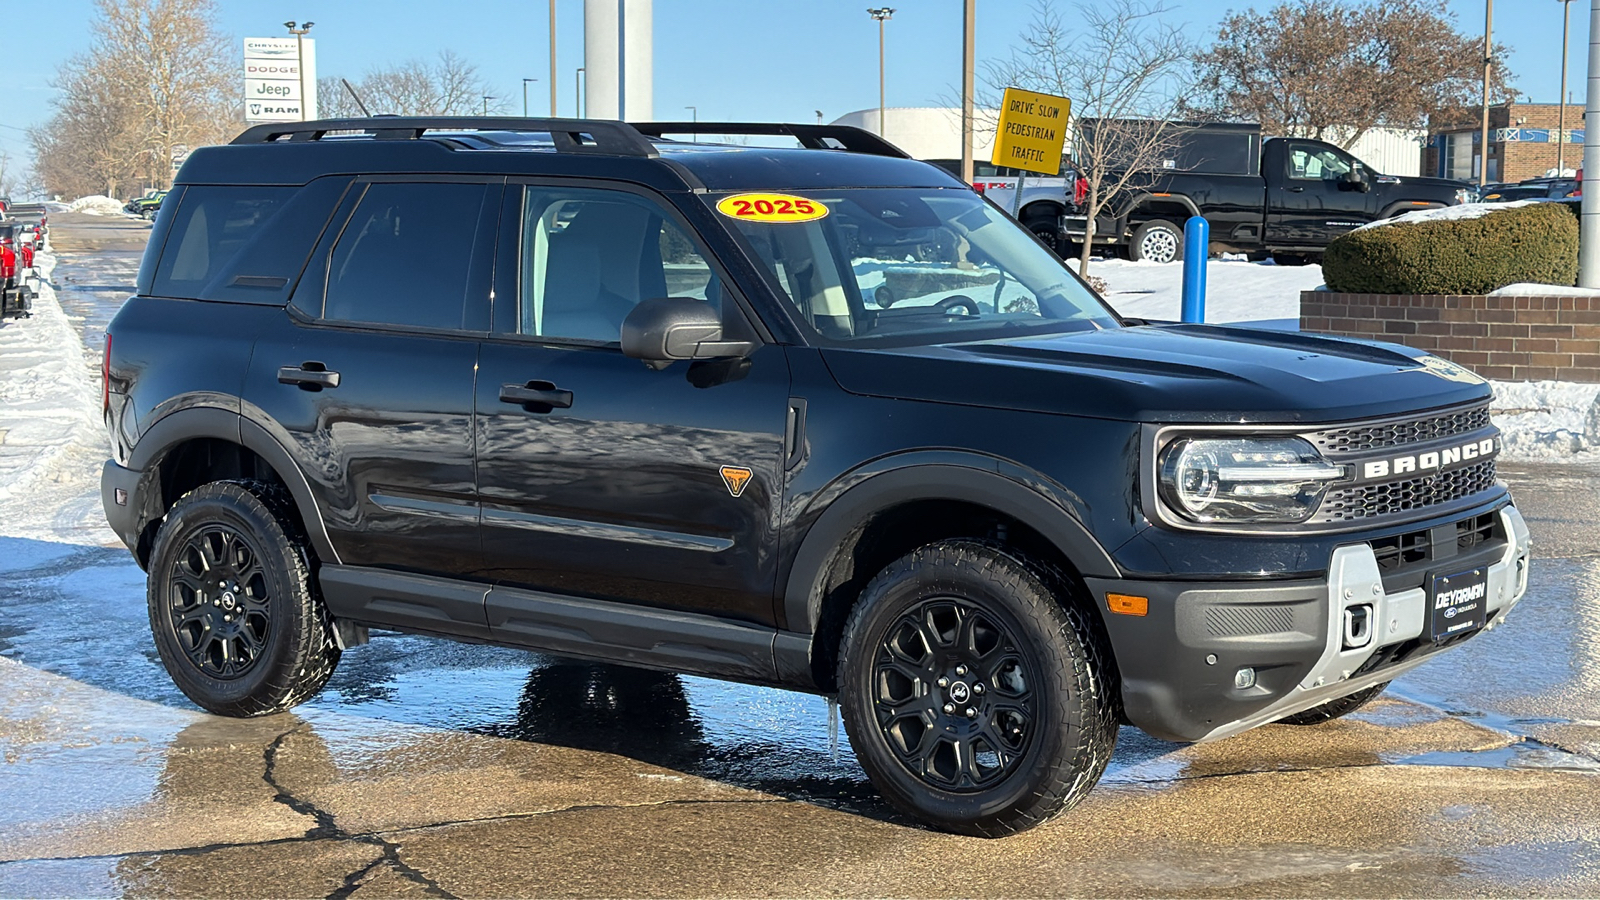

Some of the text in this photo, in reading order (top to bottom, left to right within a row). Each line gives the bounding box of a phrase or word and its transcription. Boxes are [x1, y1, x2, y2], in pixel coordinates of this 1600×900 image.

[256, 82, 291, 97] Jeep
[1009, 99, 1060, 119] DRIVE SLOW
[1005, 121, 1056, 141] PEDESTRIAN
[1011, 145, 1045, 162] TRAFFIC
[732, 199, 816, 216] 2025
[1364, 438, 1494, 479] BRONCO
[1435, 582, 1486, 610] DEYARMAN
